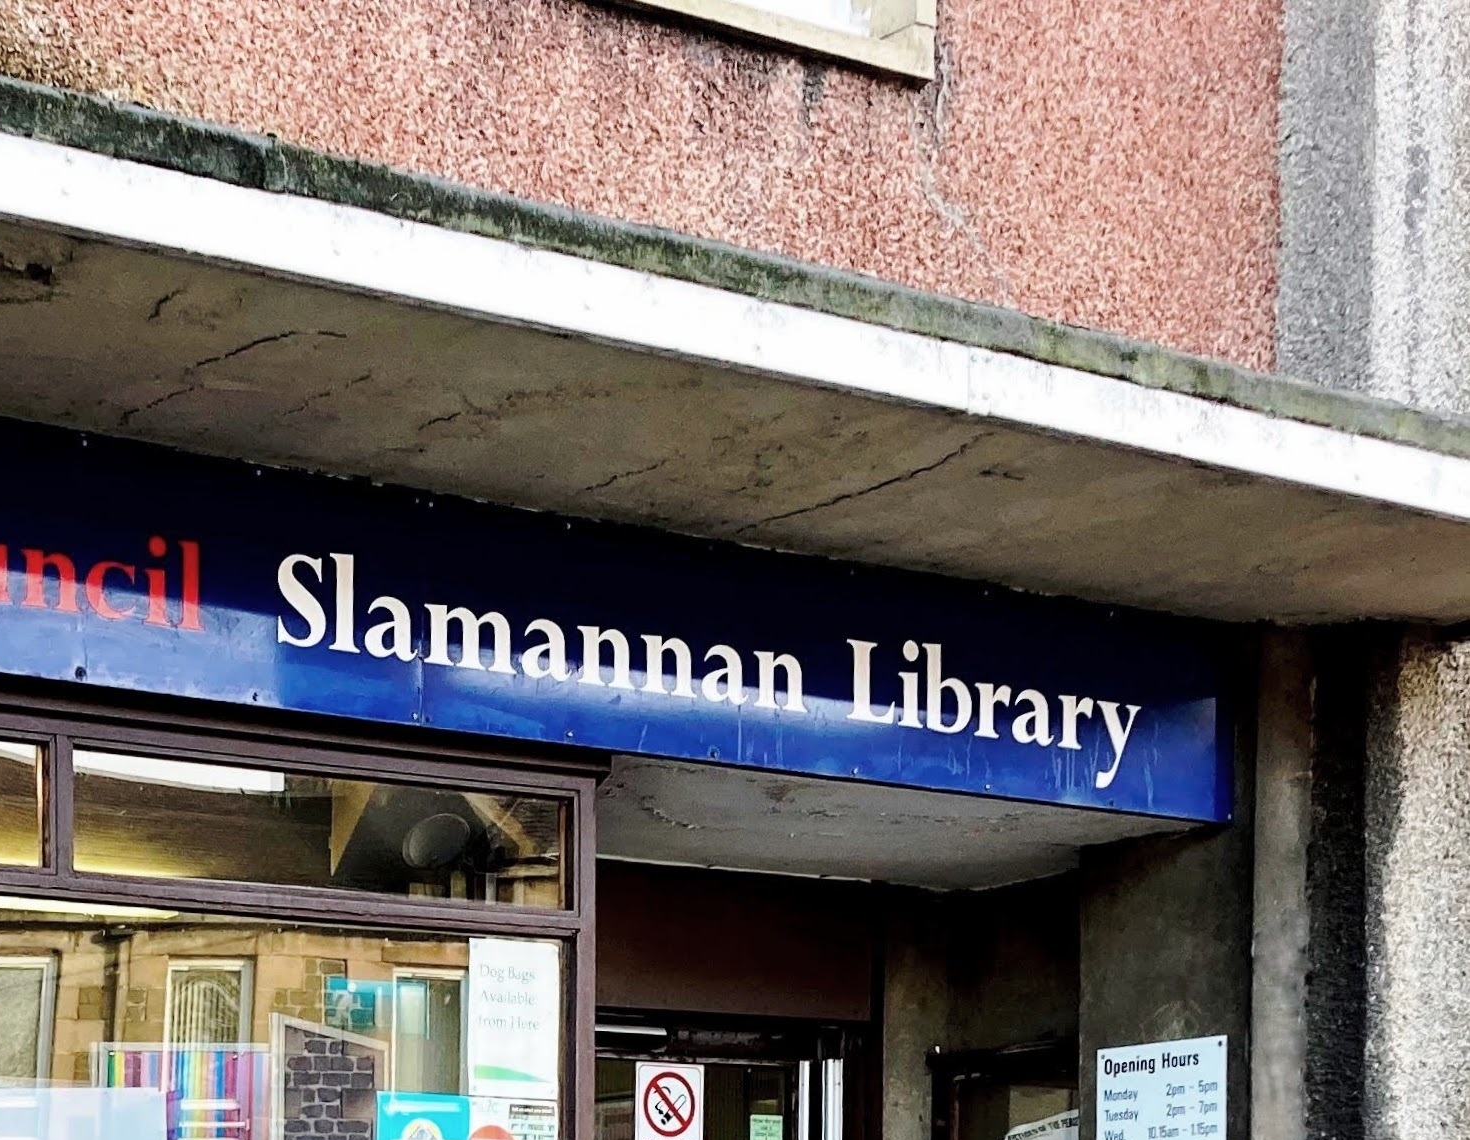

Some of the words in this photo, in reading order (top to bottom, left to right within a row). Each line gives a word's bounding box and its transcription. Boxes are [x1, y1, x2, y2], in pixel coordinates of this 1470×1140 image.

[276, 551, 810, 715] Slamannan
[845, 637, 1142, 788] Library
[479, 963, 504, 982] Dog
[508, 966, 535, 985] Bags
[481, 989, 535, 1006] Available
[478, 1015, 506, 1028] from
[510, 1015, 539, 1030] Here
[1104, 1055, 1155, 1078] Opening
[1161, 1052, 1199, 1070] Hours
[1103, 1088, 1139, 1102] Monday
[1166, 1083, 1186, 1098] 2pm
[1198, 1080, 1218, 1095] 5pm
[1104, 1108, 1139, 1122] Tuesday
[1166, 1103, 1186, 1118] 2pm
[1199, 1100, 1218, 1115] 7pm
